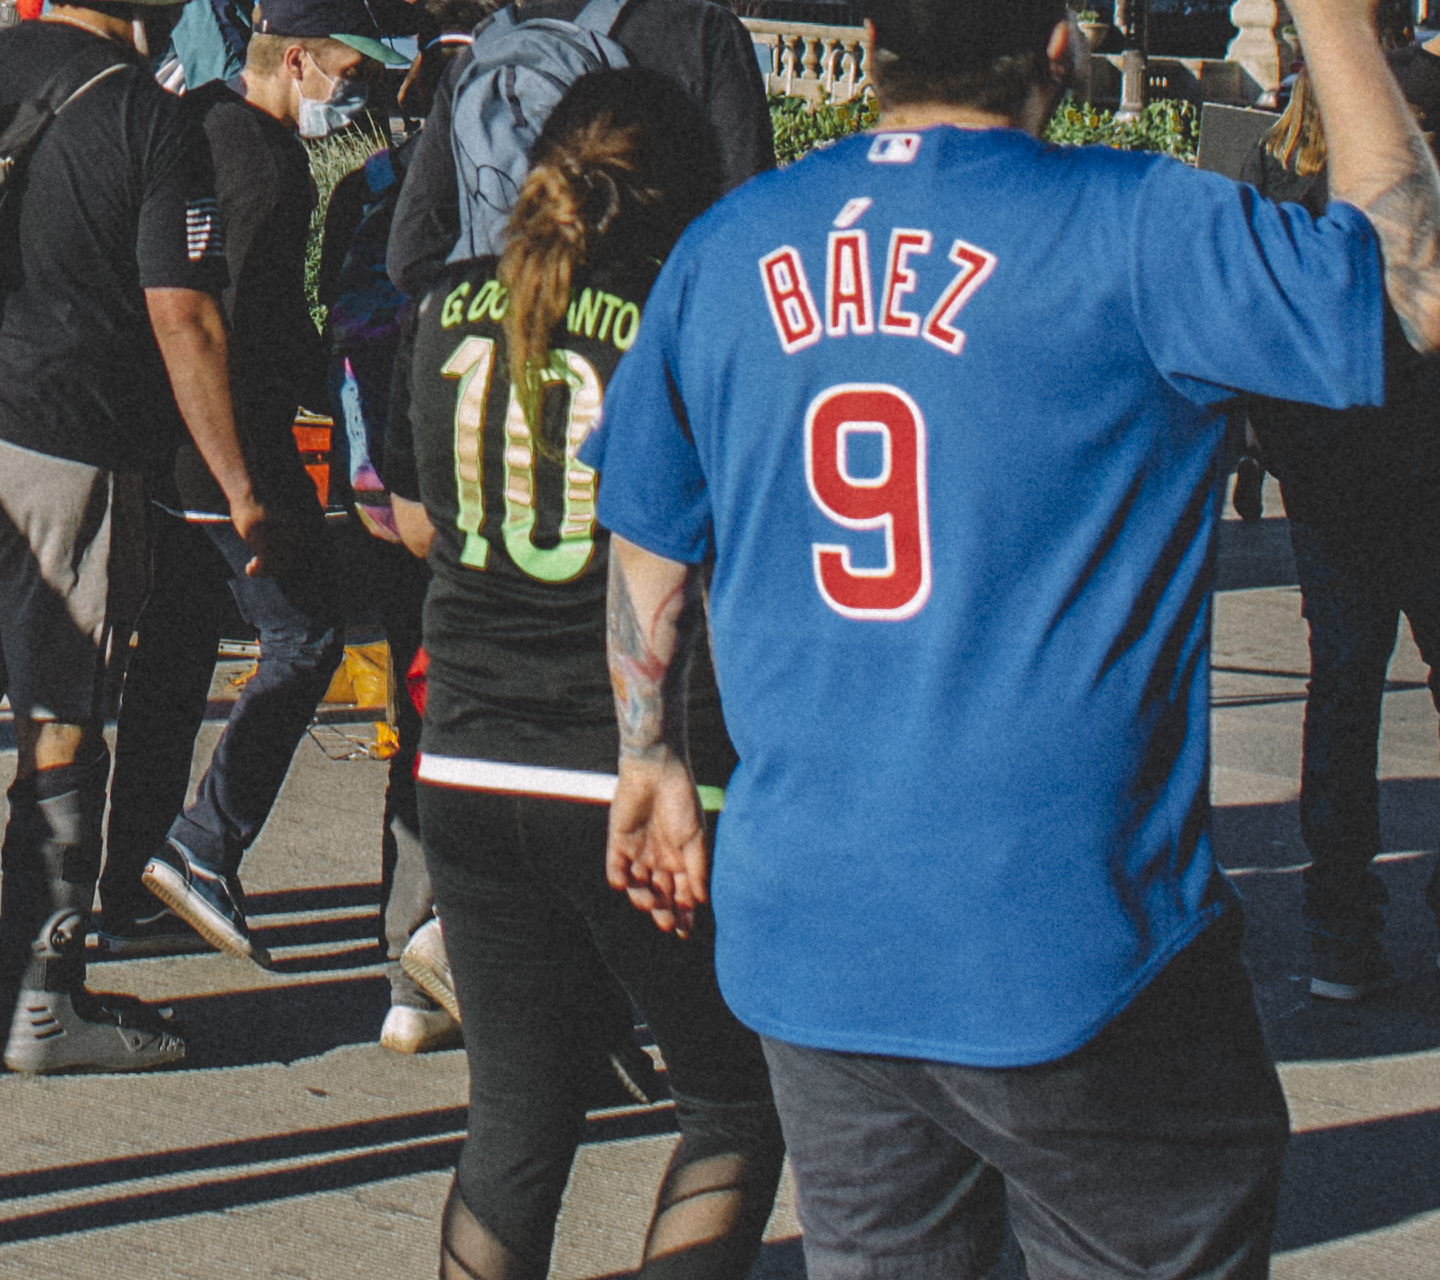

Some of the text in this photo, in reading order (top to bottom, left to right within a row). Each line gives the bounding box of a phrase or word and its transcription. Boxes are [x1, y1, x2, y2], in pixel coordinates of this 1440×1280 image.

[758, 197, 996, 354] BÁEZ
[440, 335, 604, 583] 10
[804, 382, 931, 621] 9
